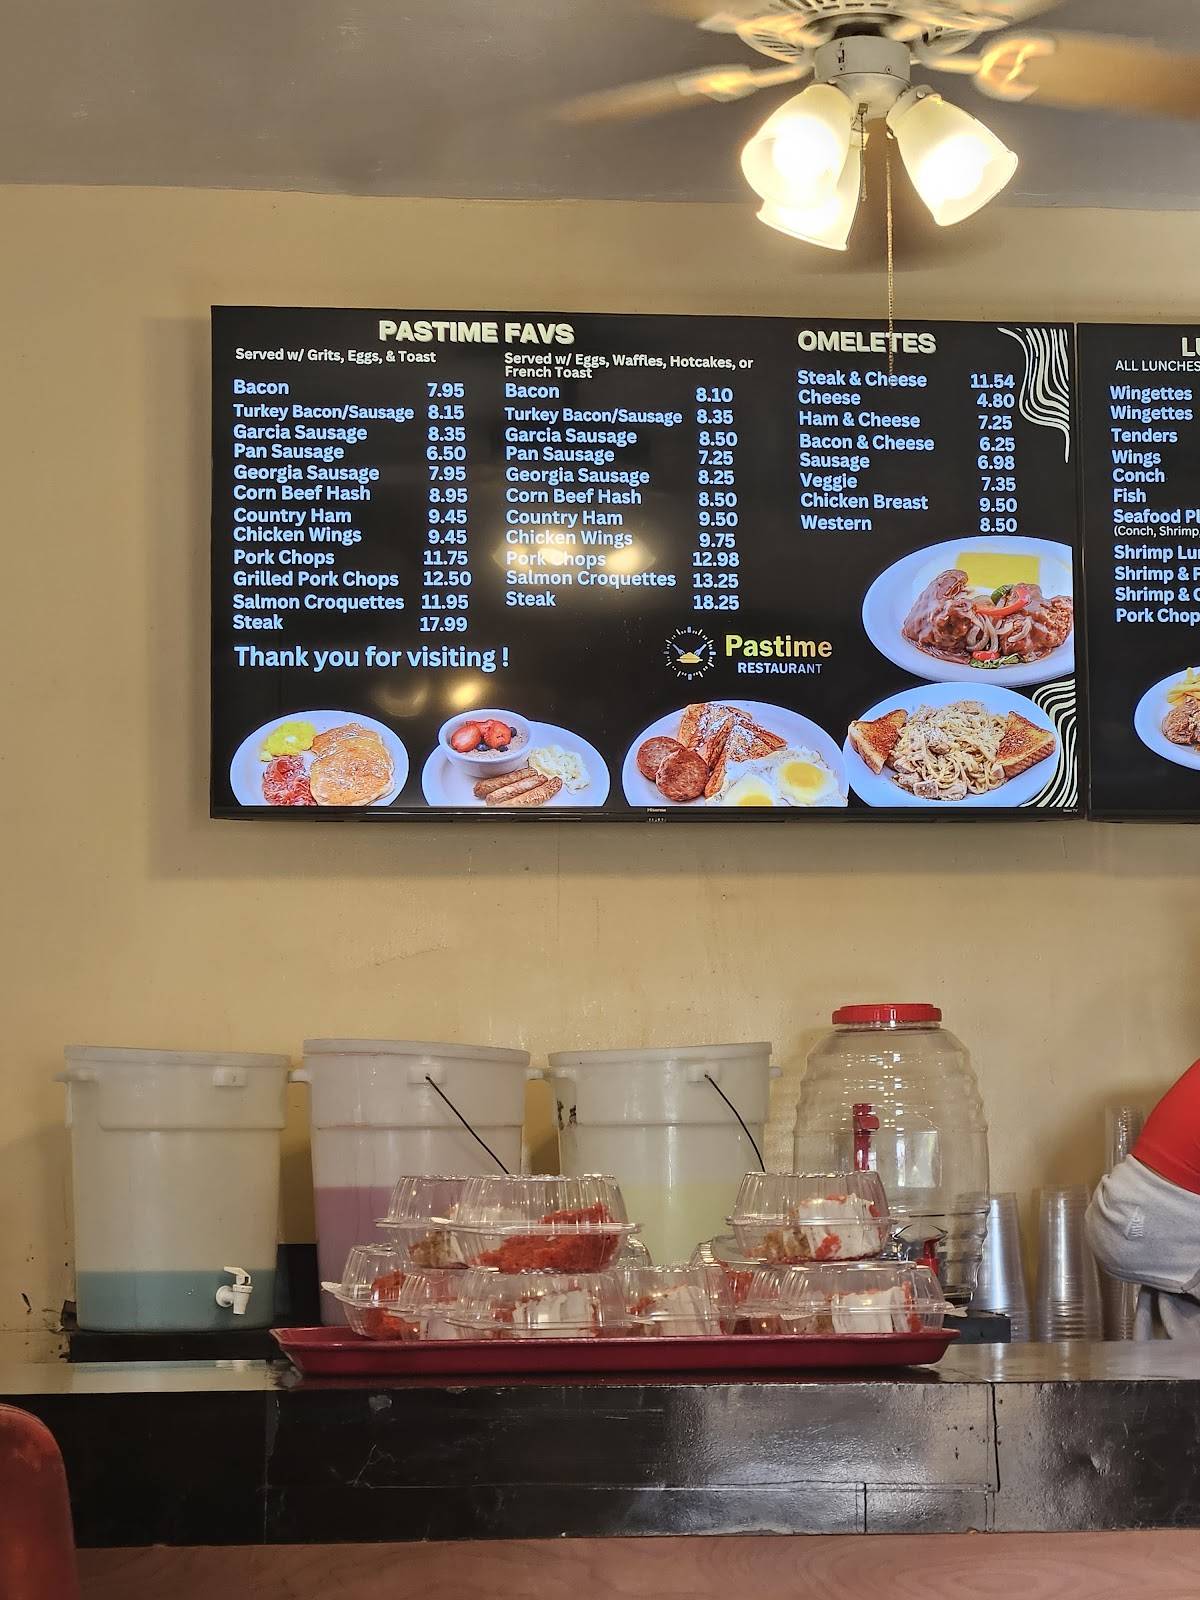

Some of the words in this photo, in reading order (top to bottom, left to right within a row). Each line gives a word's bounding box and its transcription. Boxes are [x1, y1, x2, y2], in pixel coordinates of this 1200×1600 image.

[379, 320, 499, 344] PASTIME
[505, 323, 575, 345] FAVS
[798, 330, 936, 354] OMELETES
[236, 348, 284, 360] Served
[287, 350, 304, 361] w/
[308, 349, 345, 363] Grits,
[348, 350, 382, 364] Eggs,
[386, 351, 395, 361] &
[399, 351, 436, 363] Toast
[504, 353, 551, 364] Served
[555, 353, 572, 365] w/
[576, 354, 609, 368] Eggs,
[612, 355, 667, 369] Waffles,
[670, 356, 736, 370] Hotcakes,
[739, 359, 753, 368] or
[505, 366, 551, 377] French
[555, 367, 592, 378] Toast
[1116, 360, 1138, 371] ALL
[234, 379, 289, 395] Bacon
[427, 383, 464, 397] 7.95
[798, 370, 845, 385] Steak
[849, 372, 861, 386] &
[865, 372, 927, 387] Cheese
[971, 374, 1015, 389] 11.54
[505, 384, 560, 398] Bacon
[696, 388, 733, 402] 8.10
[798, 390, 860, 404] Cheese
[977, 394, 1015, 408] 4.80
[1110, 386, 1192, 404] Wingettes
[234, 404, 288, 421] Turkey
[293, 405, 414, 422] Bacon/Sausage
[428, 405, 464, 420] 8.15
[505, 408, 559, 424] Turkey
[563, 408, 682, 426] Bacon/Sausage
[697, 410, 733, 424] 8.35
[799, 411, 838, 426] Ham
[843, 413, 854, 427] &
[858, 412, 920, 428] Cheese
[978, 415, 1012, 430] 7.25
[1110, 405, 1194, 423] Wingettes
[234, 425, 290, 440] Garcia
[295, 426, 367, 443] Sausage
[428, 427, 466, 441] 8.35
[505, 428, 562, 443] Garcia
[566, 429, 637, 447] Sausage
[699, 432, 737, 446] 8.50
[799, 434, 852, 449] Bacon
[857, 435, 869, 450] &
[873, 435, 934, 451] Cheese
[980, 438, 1015, 452] 6.25
[1111, 428, 1178, 442] Tenders
[234, 444, 267, 458] Pan
[271, 444, 344, 462] Sausage
[426, 446, 466, 460] 6.50
[506, 447, 538, 461] Pan
[543, 447, 614, 465] Sausage
[698, 450, 733, 465] 7.25
[1112, 450, 1161, 467] Wings
[799, 453, 870, 472] Sausage
[978, 455, 1015, 470] 6.98
[234, 465, 303, 483] Georgia
[307, 465, 379, 483] Sausage
[429, 466, 466, 480] 7.95
[506, 467, 574, 485] Georgia
[578, 468, 649, 486] Sausage
[698, 470, 734, 484] 8.25
[800, 473, 857, 491] Veggie
[982, 477, 1016, 491] 7.35
[1112, 469, 1165, 482] Conch
[234, 486, 276, 500] Corn
[282, 485, 323, 500] Beef
[327, 486, 370, 500] Hash
[429, 488, 468, 503] 8.95
[506, 488, 548, 503] Corn
[554, 489, 594, 503] Beef
[598, 489, 641, 504] Hash
[698, 492, 737, 507] 8.50
[801, 493, 868, 509] Chicken
[874, 495, 928, 510] Breast
[980, 498, 1017, 512] 9.50
[1113, 488, 1146, 502] Fish
[234, 508, 306, 526] Country
[311, 509, 351, 523] Ham
[428, 509, 467, 524] 9.45
[506, 510, 578, 528] Country
[583, 511, 623, 525] Ham
[699, 512, 737, 526] 9.50
[801, 515, 872, 530] Western
[980, 518, 1017, 532] 8.50
[1114, 509, 1180, 523] Seafood
[234, 527, 304, 542] Chicken
[309, 528, 362, 546] Wings
[428, 530, 467, 544] 9.45
[506, 530, 576, 544] Chicken
[581, 531, 632, 548] Wings
[699, 534, 735, 548] 9.75
[1114, 526, 1156, 537] (Conch,
[234, 550, 274, 565] Pork
[279, 550, 335, 568] Chops
[424, 550, 468, 565] 11.75
[506, 552, 546, 565] Pork
[693, 552, 739, 567] 12.98
[1114, 545, 1173, 563] Shrimp
[233, 571, 292, 586] Grilled
[299, 571, 338, 586] Pork
[343, 572, 399, 590] Chops
[424, 571, 471, 586] 12.50
[506, 571, 572, 585] Salmon
[578, 572, 676, 589] Croquettes
[693, 574, 738, 588] 13.25
[1115, 566, 1174, 584] Shrimp
[1178, 566, 1189, 580] &
[233, 594, 300, 610] Salmon
[304, 595, 404, 613] Croquettes
[422, 595, 468, 609] 11.95
[506, 592, 556, 606] Steak
[693, 595, 739, 610] 18.25
[1115, 586, 1174, 604] Shrimp
[1178, 587, 1190, 602] &
[233, 615, 283, 630] Steak
[420, 617, 468, 632] 17.99
[1116, 608, 1154, 622] Pork
[725, 635, 832, 657] Pastime
[234, 646, 309, 667] Thank
[314, 650, 358, 672] you
[365, 646, 401, 667] for
[408, 647, 496, 672] visiting
[502, 647, 509, 667] !
[738, 663, 822, 674] RESTAURANT
